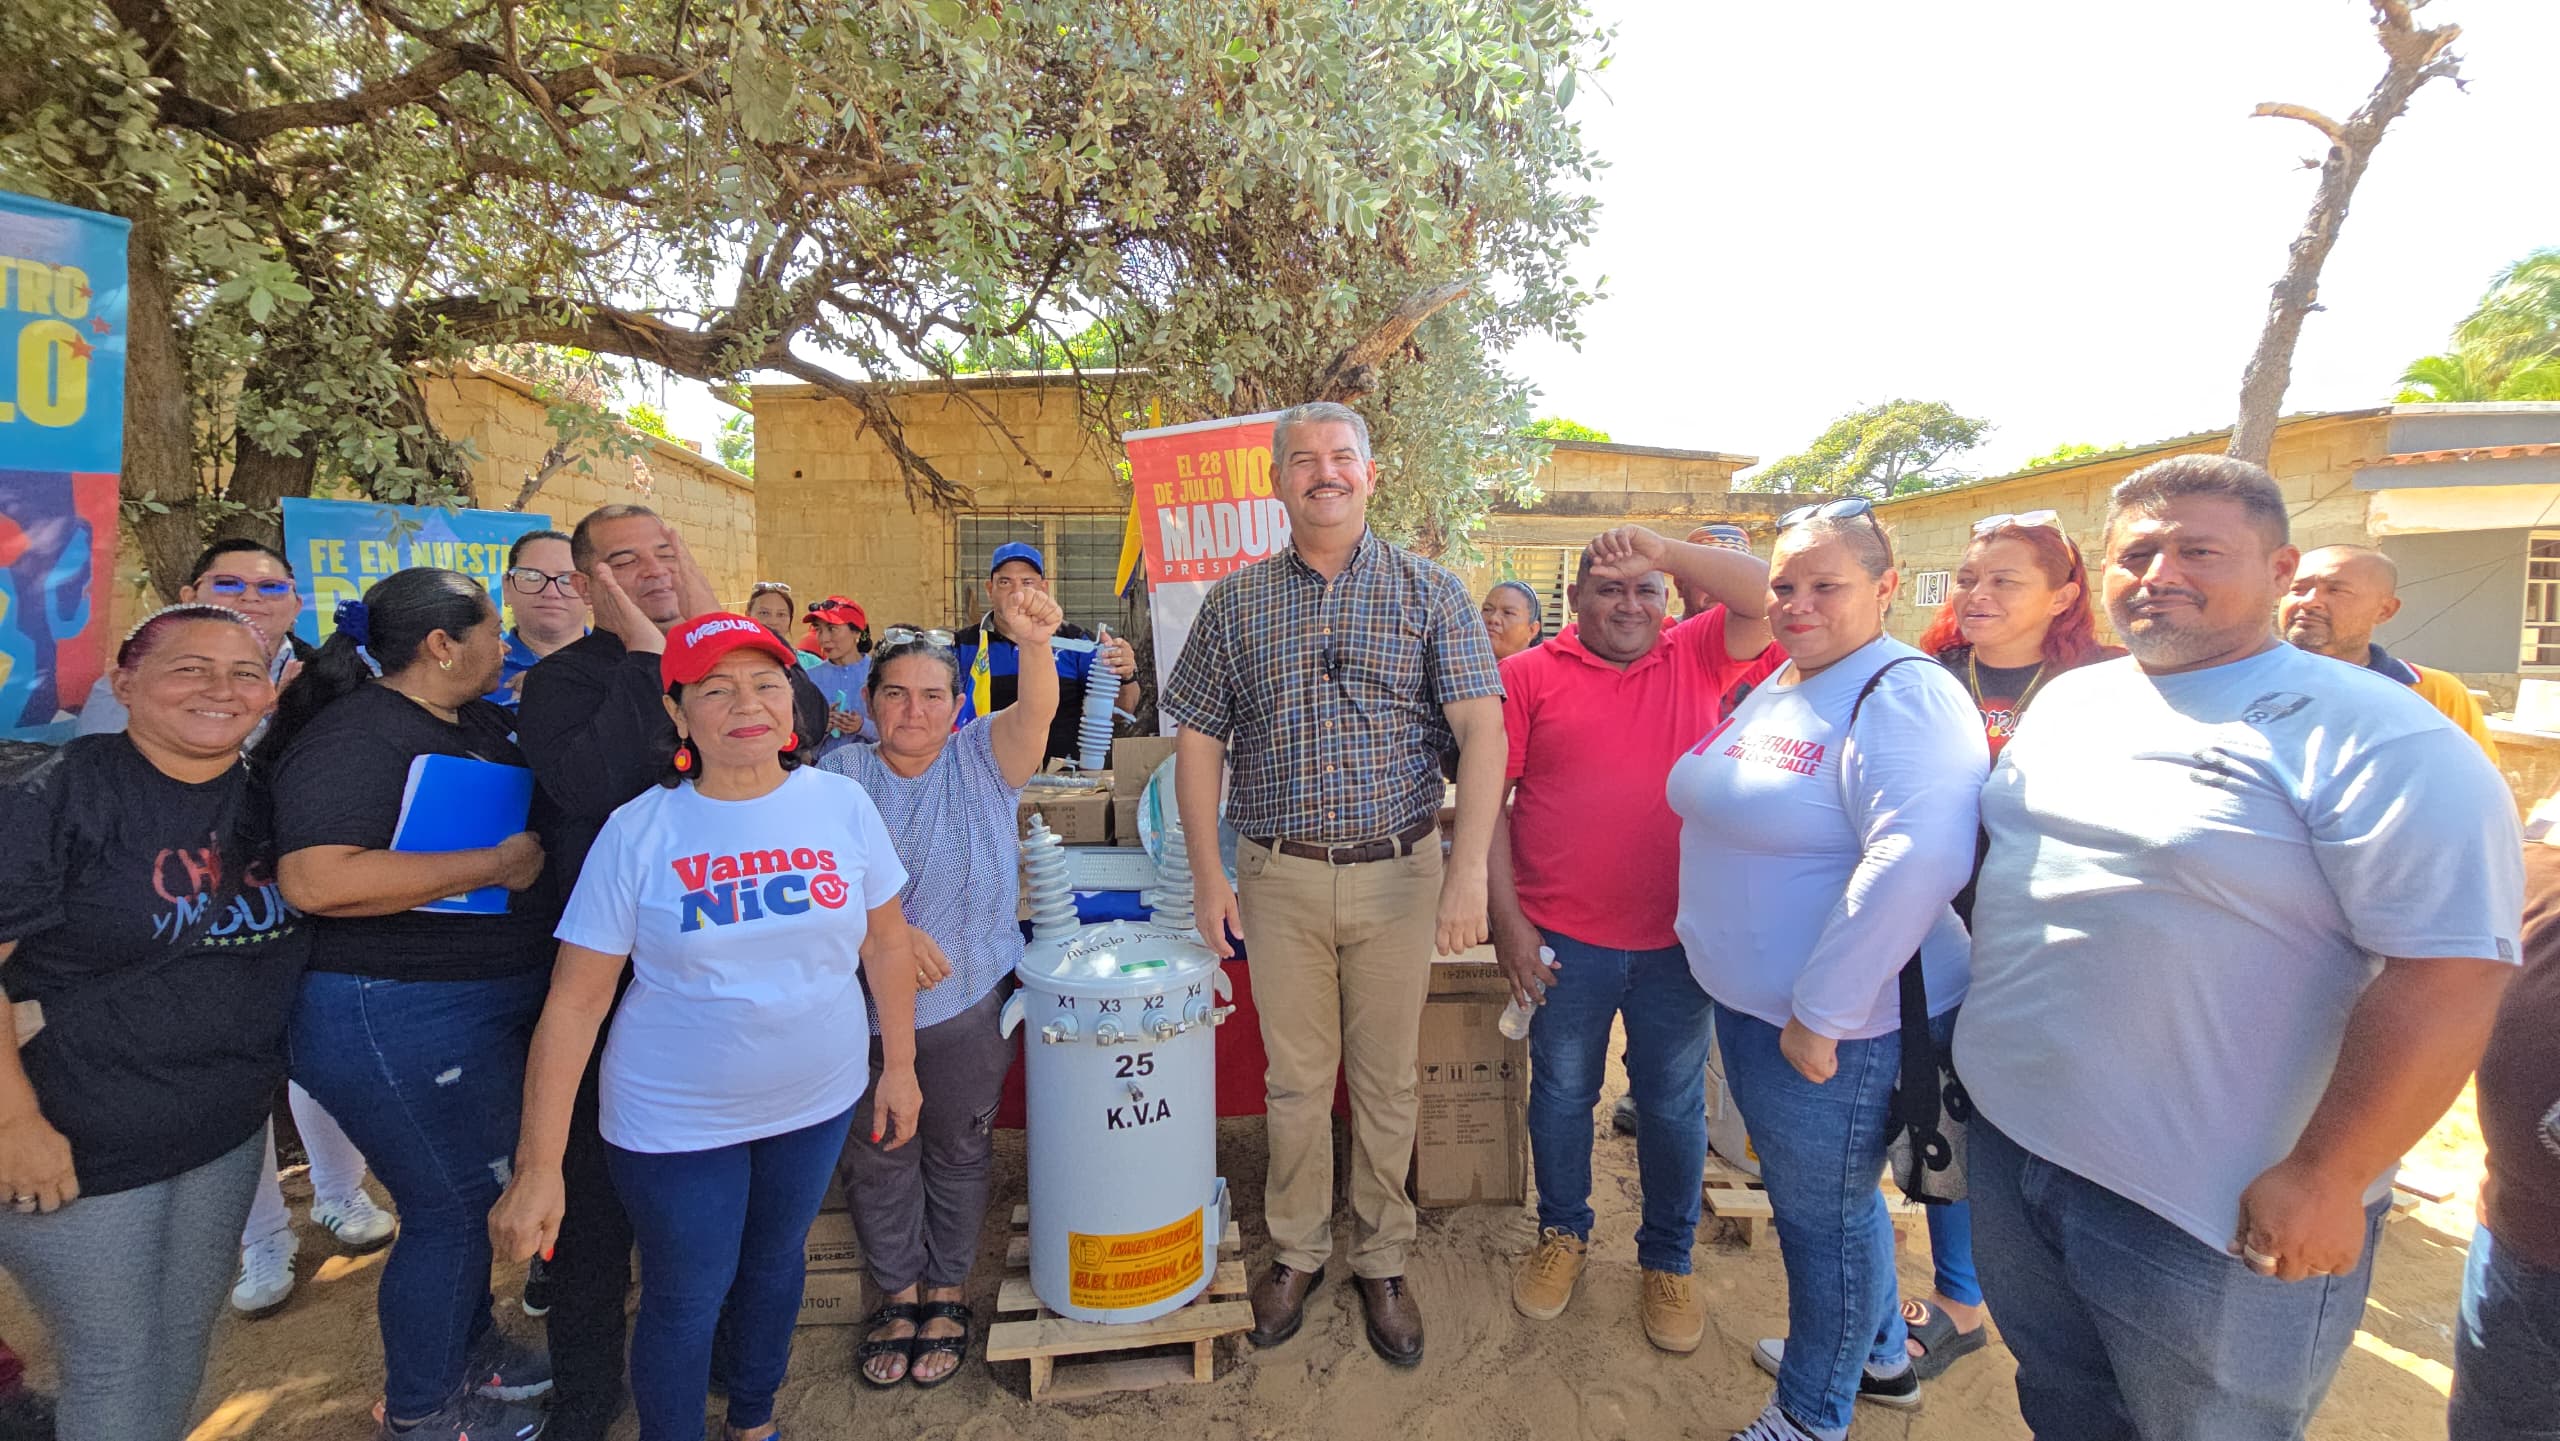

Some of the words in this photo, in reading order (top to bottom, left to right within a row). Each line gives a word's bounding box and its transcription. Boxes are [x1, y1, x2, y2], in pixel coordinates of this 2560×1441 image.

[1176, 454, 1195, 478] EL
[1199, 451, 1222, 476] 28
[1224, 446, 1273, 499] VO
[1153, 482, 1175, 506] DE
[1180, 477, 1224, 504] JULIO
[1158, 498, 1292, 561] MADUR
[309, 539, 349, 574] FE
[359, 540, 400, 574] EN
[410, 541, 511, 575] NUEST
[1776, 756, 1820, 777] CALLE
[672, 847, 838, 892] Vamos
[1058, 994, 1076, 1009] X1
[1143, 995, 1165, 1011] X2
[1187, 983, 1202, 999] X4
[1099, 999, 1122, 1013] X3
[1115, 1051, 1155, 1079] 25
[1107, 1098, 1171, 1131] K.V.A
[801, 1297, 841, 1309] UTOUT
